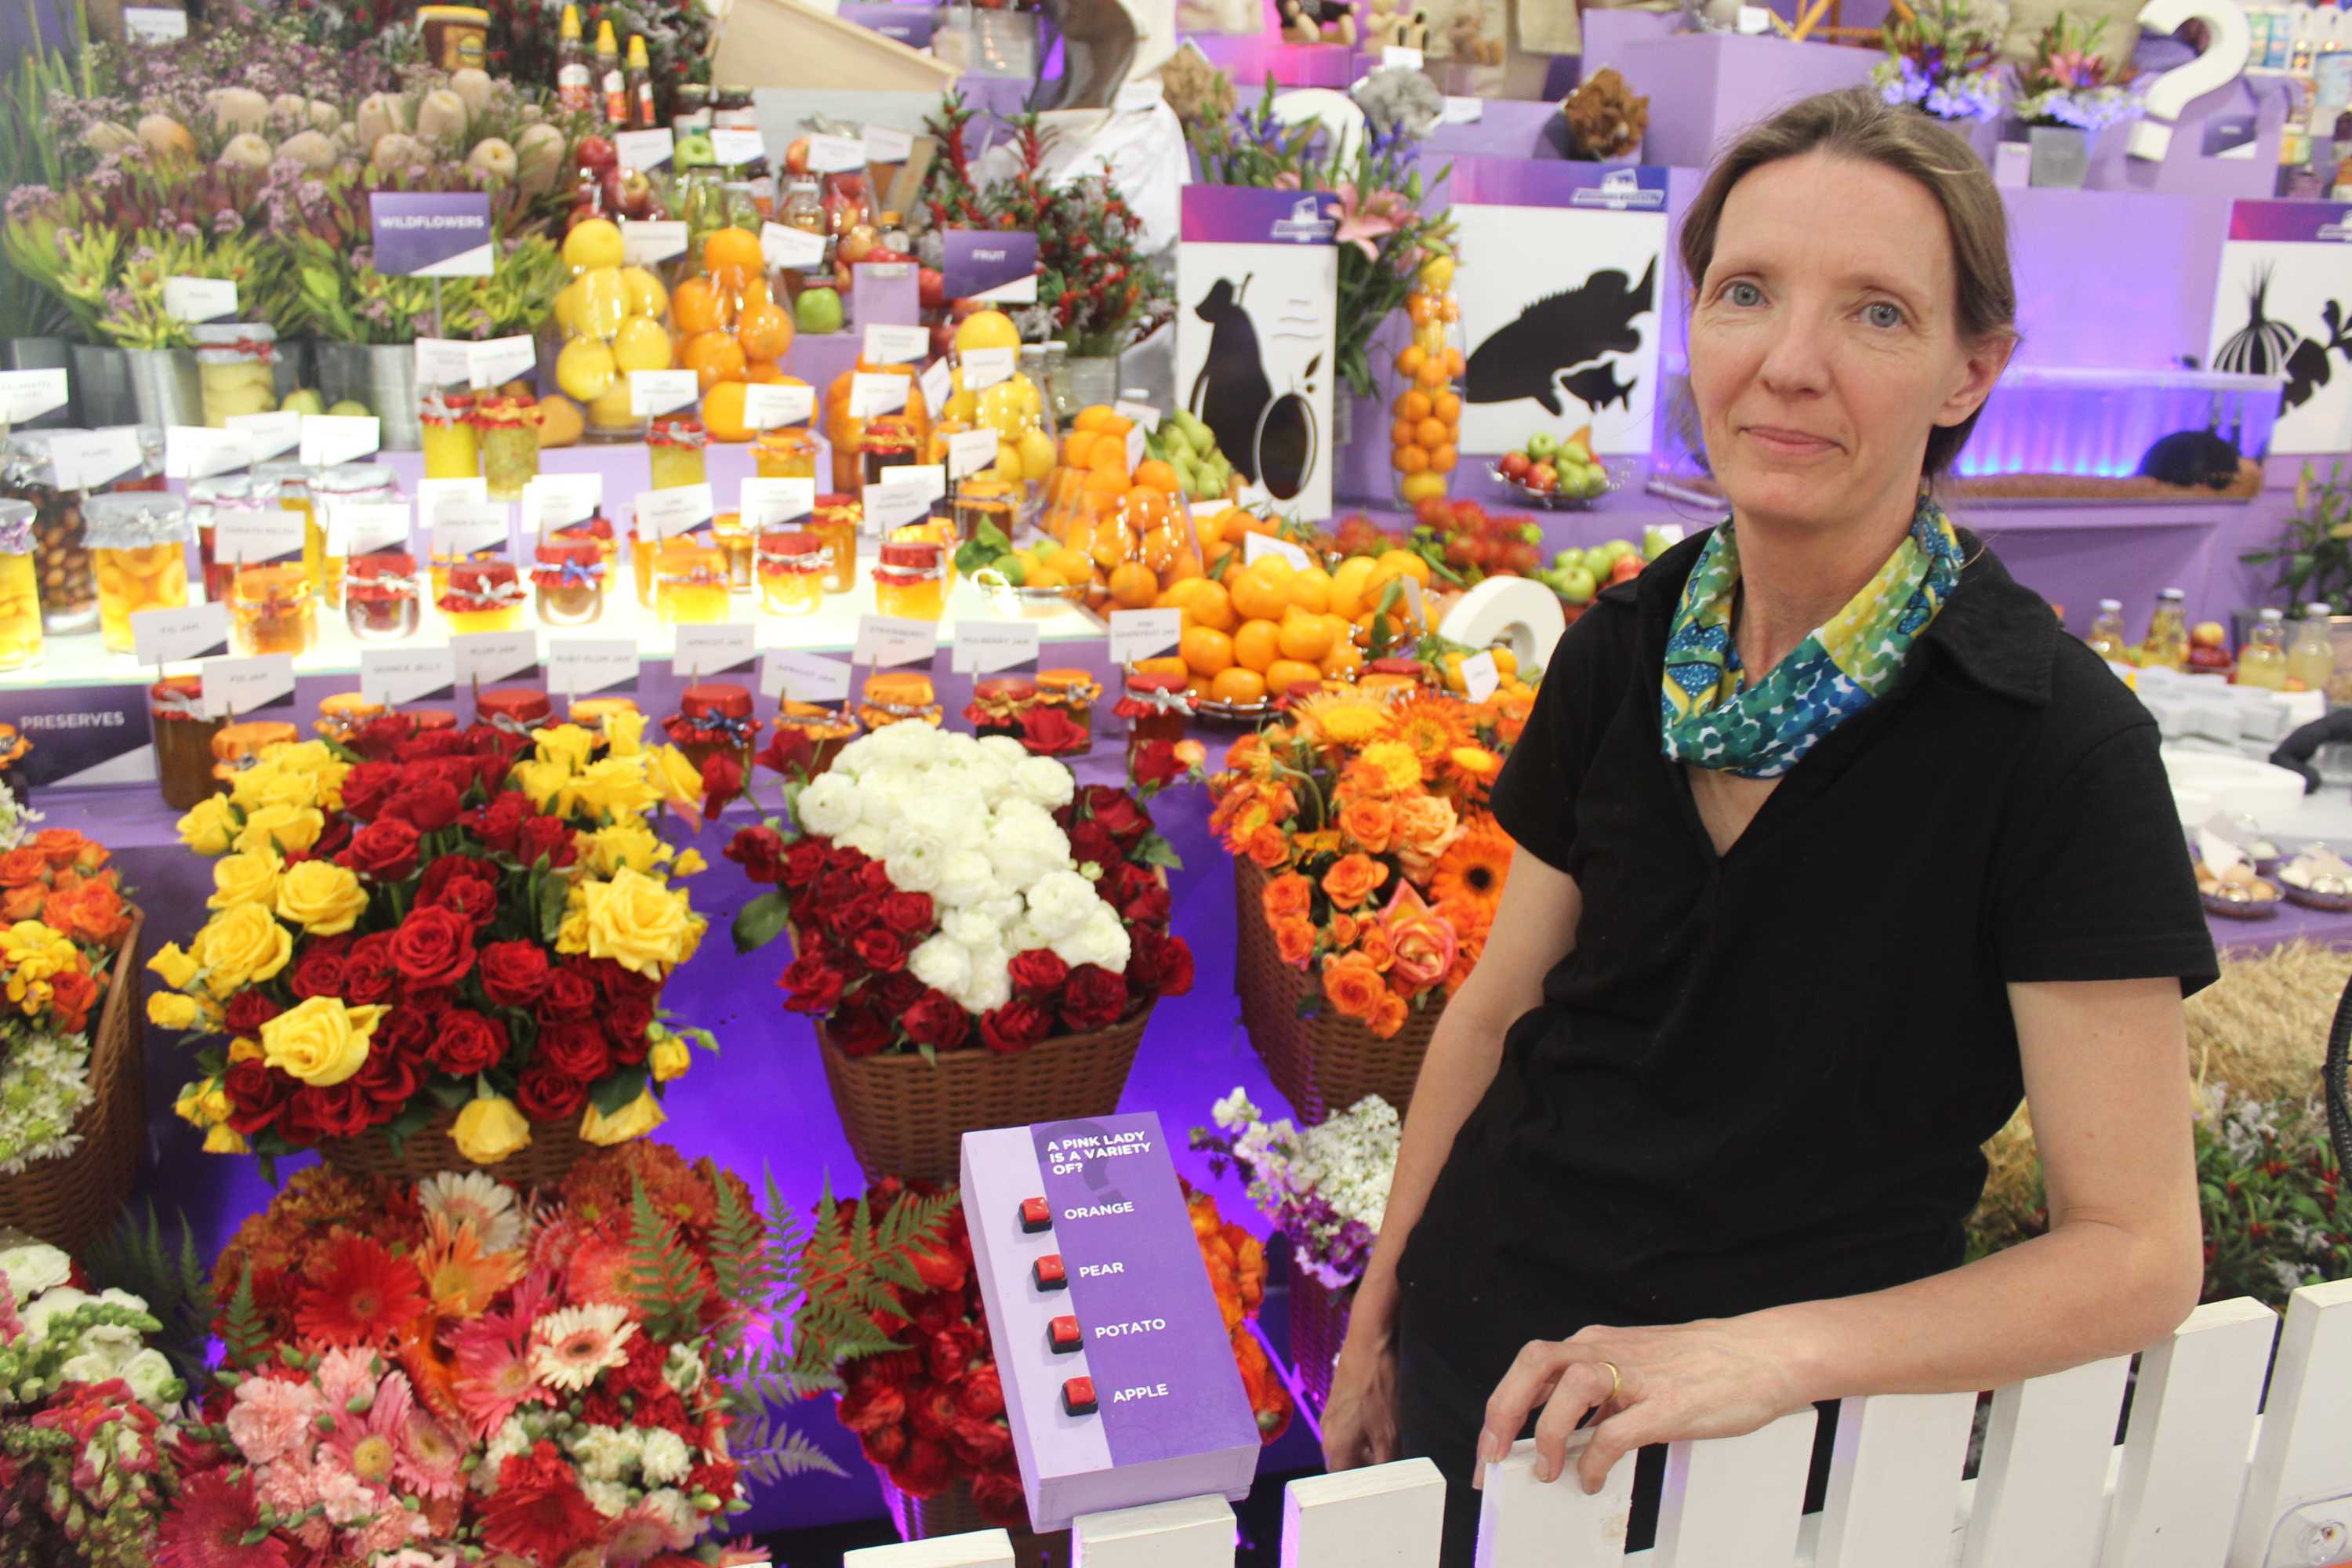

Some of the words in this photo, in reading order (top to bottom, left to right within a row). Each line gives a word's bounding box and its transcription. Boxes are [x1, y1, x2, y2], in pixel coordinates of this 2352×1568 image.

[379, 215, 485, 229] WILDFLOWERS
[971, 249, 1008, 263] FRUIT
[20, 710, 125, 730] PRESERVES
[1047, 1142, 1059, 1152] A
[1062, 1136, 1100, 1150] PINK
[1103, 1131, 1145, 1145] LADY
[1049, 1152, 1065, 1163] IS
[1069, 1151, 1081, 1162] A
[1083, 1142, 1151, 1159] VARIETY
[1052, 1162, 1083, 1175] OF?
[1064, 1201, 1134, 1220] ORANGE
[1079, 1262, 1125, 1278] PEAR
[1094, 1318, 1167, 1339] POTATO
[1112, 1383, 1169, 1403] APPLE
